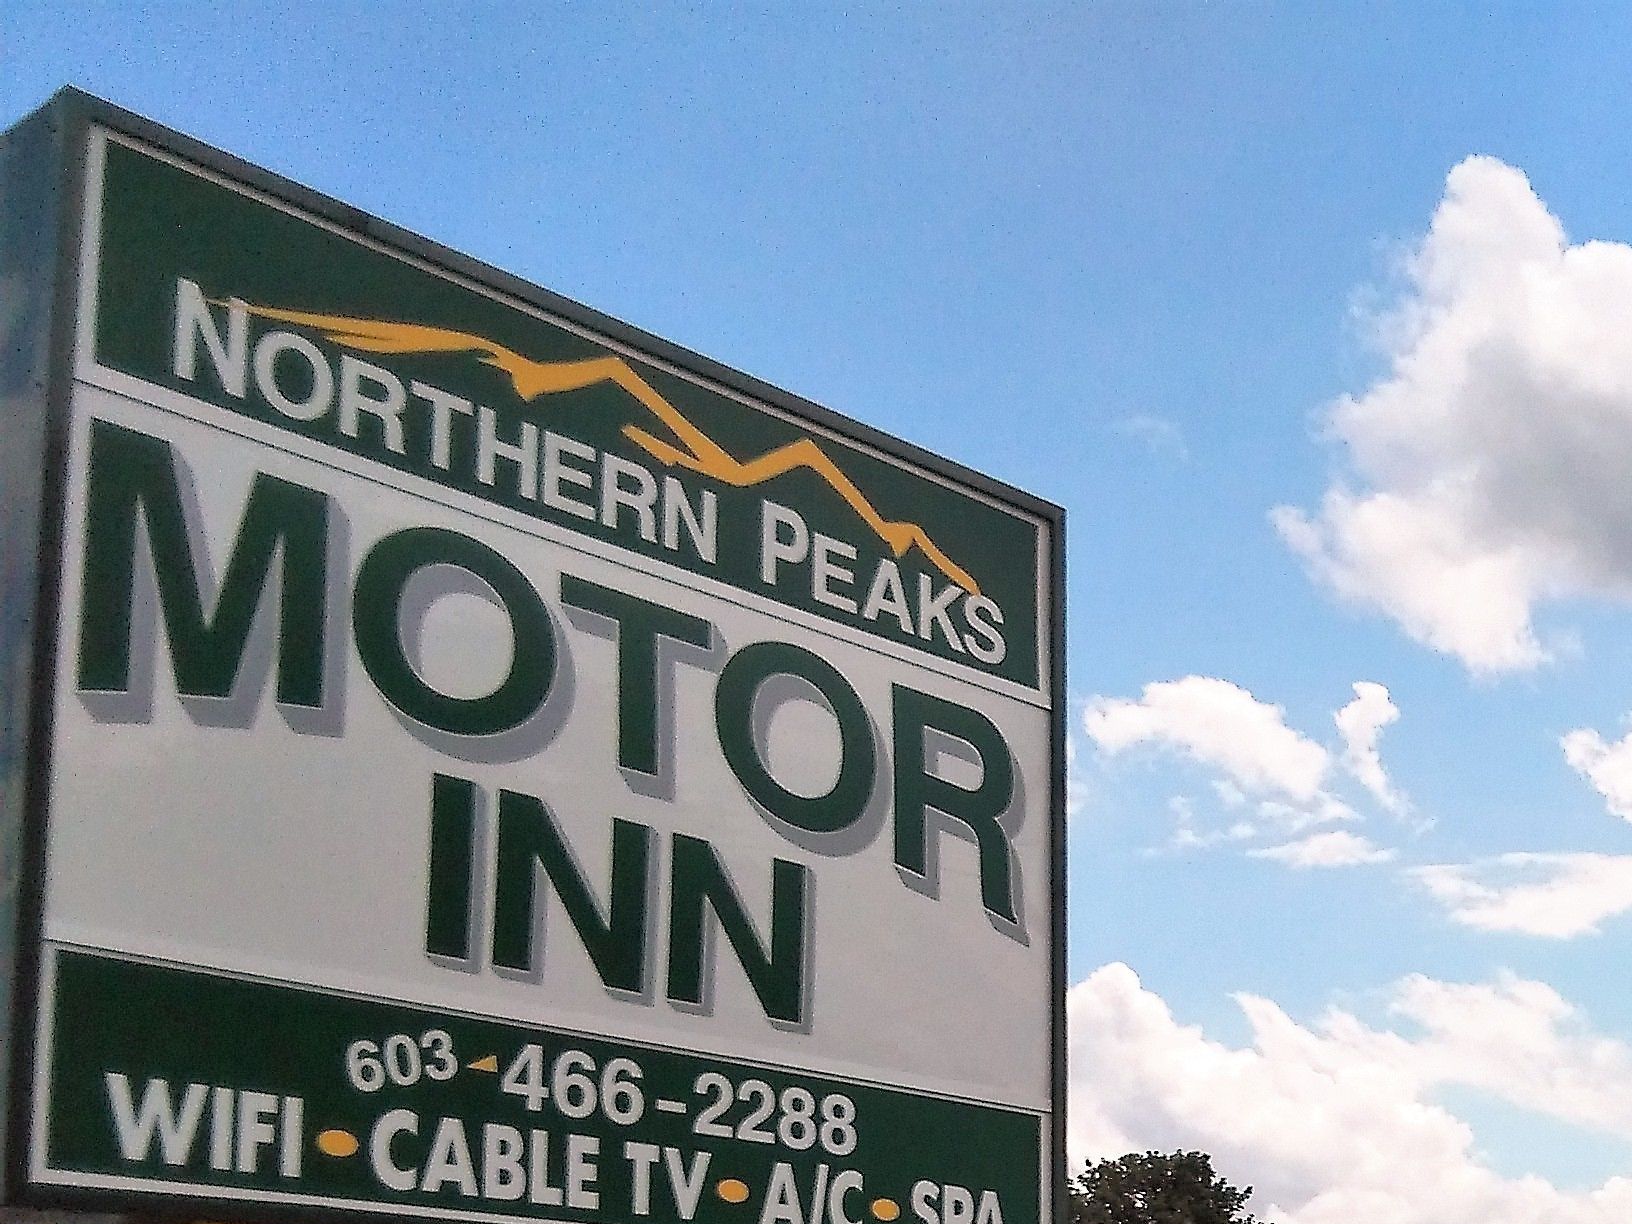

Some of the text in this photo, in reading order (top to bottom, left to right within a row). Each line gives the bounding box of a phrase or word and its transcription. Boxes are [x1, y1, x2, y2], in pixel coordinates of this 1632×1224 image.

[172, 278, 1008, 666] NORTHERN PEAKS
[76, 415, 1028, 946] MOTOR
[426, 771, 813, 1036] INN
[104, 1070, 304, 1178] WIFI
[370, 1107, 601, 1209] CABLE
[623, 1140, 712, 1222] TV
